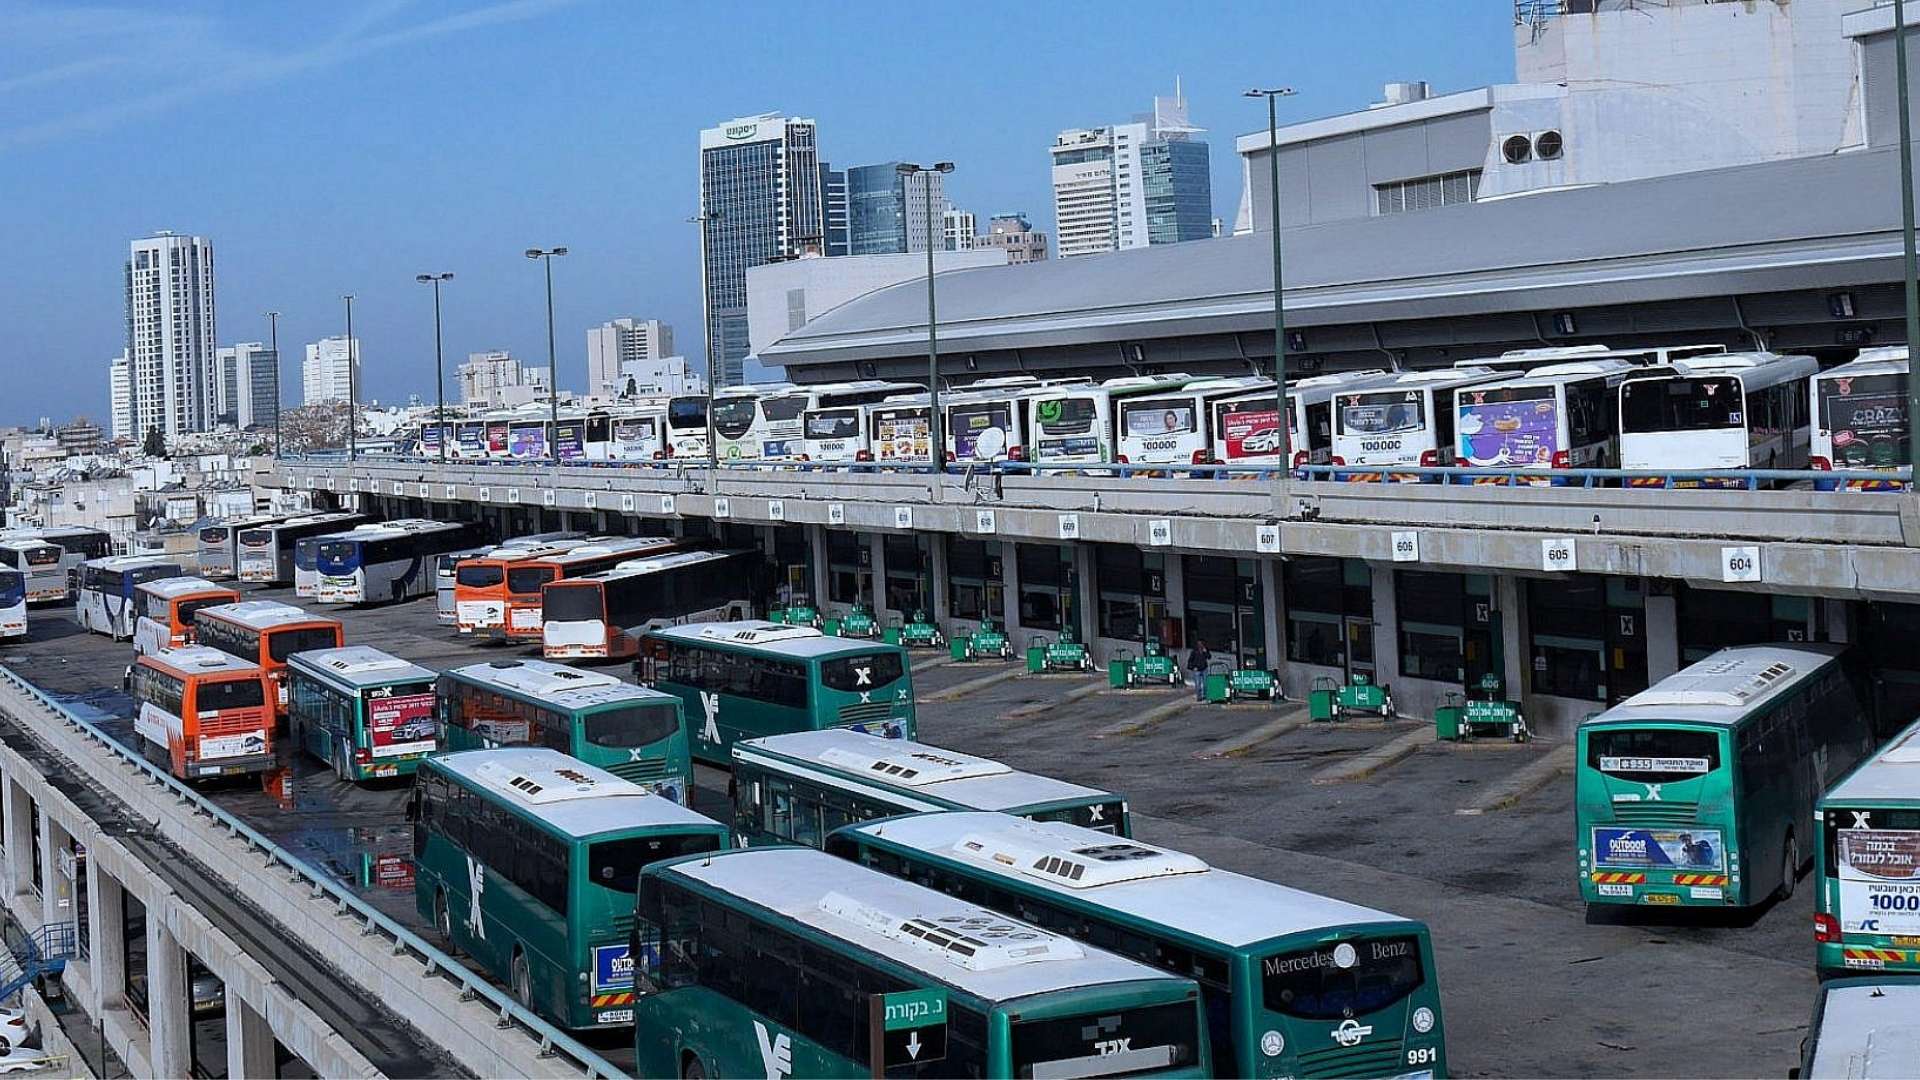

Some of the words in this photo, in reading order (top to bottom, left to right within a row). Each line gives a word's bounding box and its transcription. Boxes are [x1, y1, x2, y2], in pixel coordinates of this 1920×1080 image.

[1062, 522, 1075, 531] 609
[1261, 534, 1274, 544] 607
[1396, 541, 1413, 552] 606
[1548, 549, 1568, 560] 605
[1730, 558, 1751, 570] 604
[1609, 839, 1647, 850] OUTDOOR
[1265, 951, 1335, 977] Mercedes
[1371, 942, 1407, 960] Benz
[884, 1001, 929, 1021] בקורת
[1407, 1047, 1437, 1064] 991
